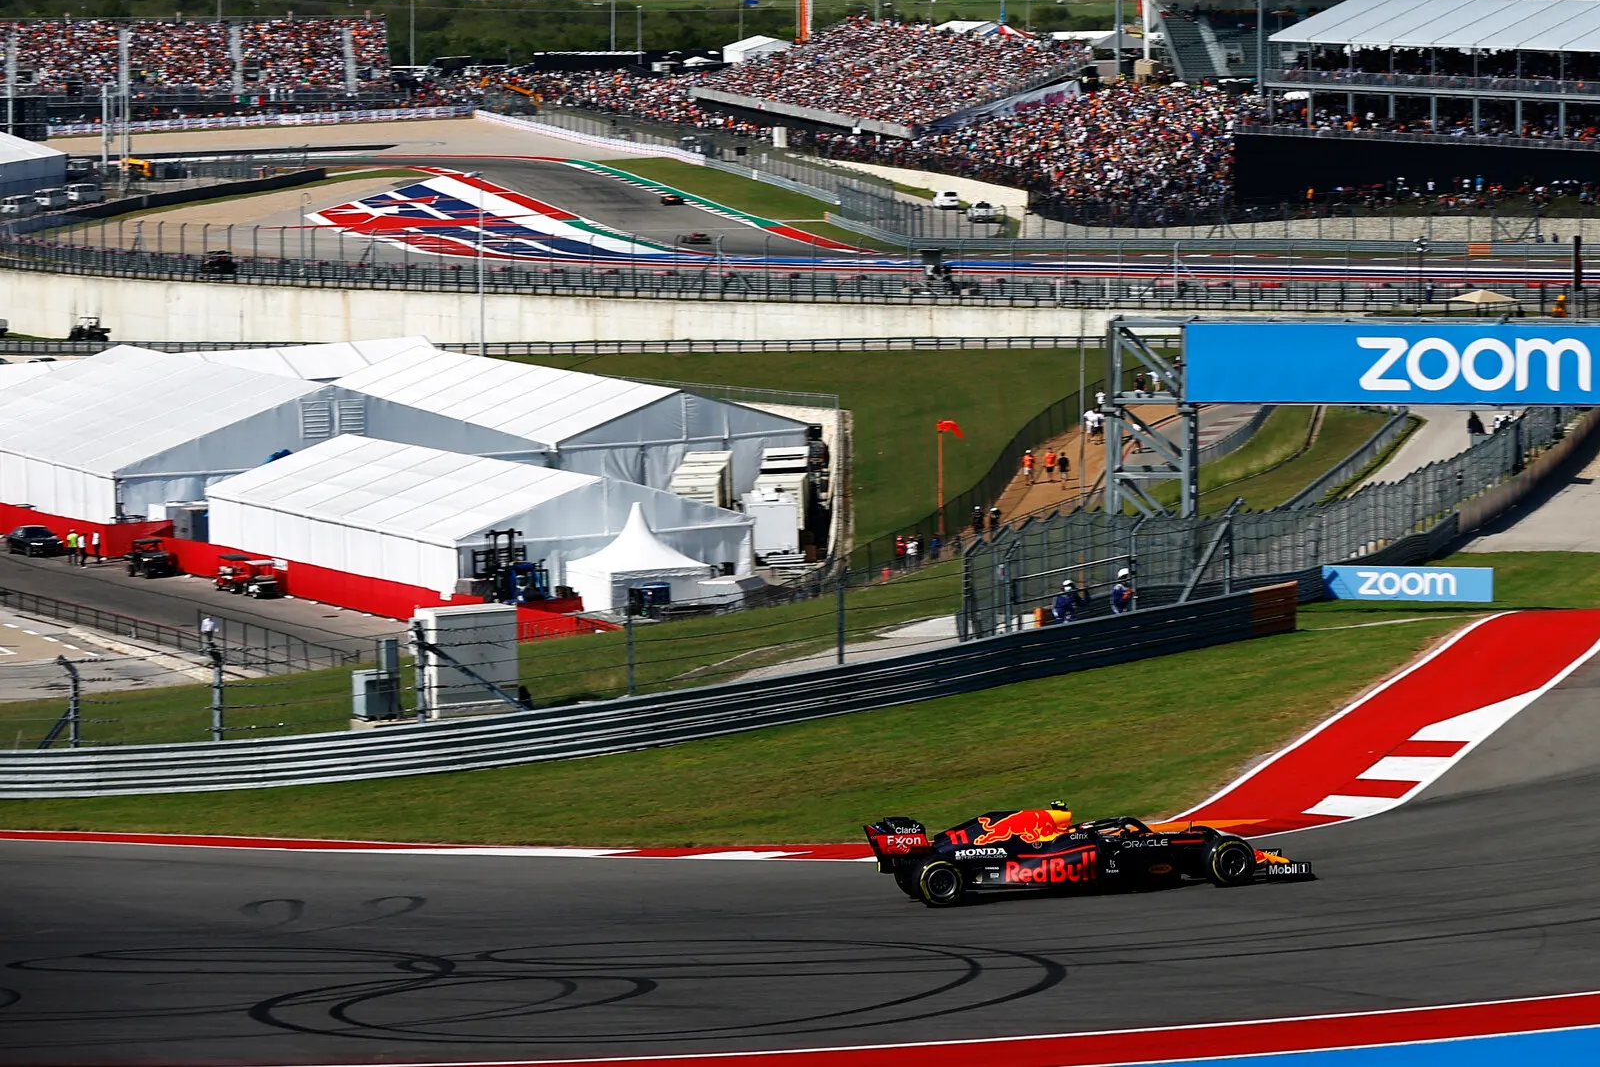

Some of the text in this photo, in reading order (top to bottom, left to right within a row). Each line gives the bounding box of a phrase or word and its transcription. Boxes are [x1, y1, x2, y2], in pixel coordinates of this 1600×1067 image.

[1356, 336, 1592, 392] zoom
[1356, 571, 1457, 596] zoom
[895, 825, 918, 834] Claro
[946, 830, 968, 845] 11
[1122, 838, 1169, 848] ORACLE
[955, 847, 1008, 857] HONDA
[1268, 863, 1297, 875] Mobil
